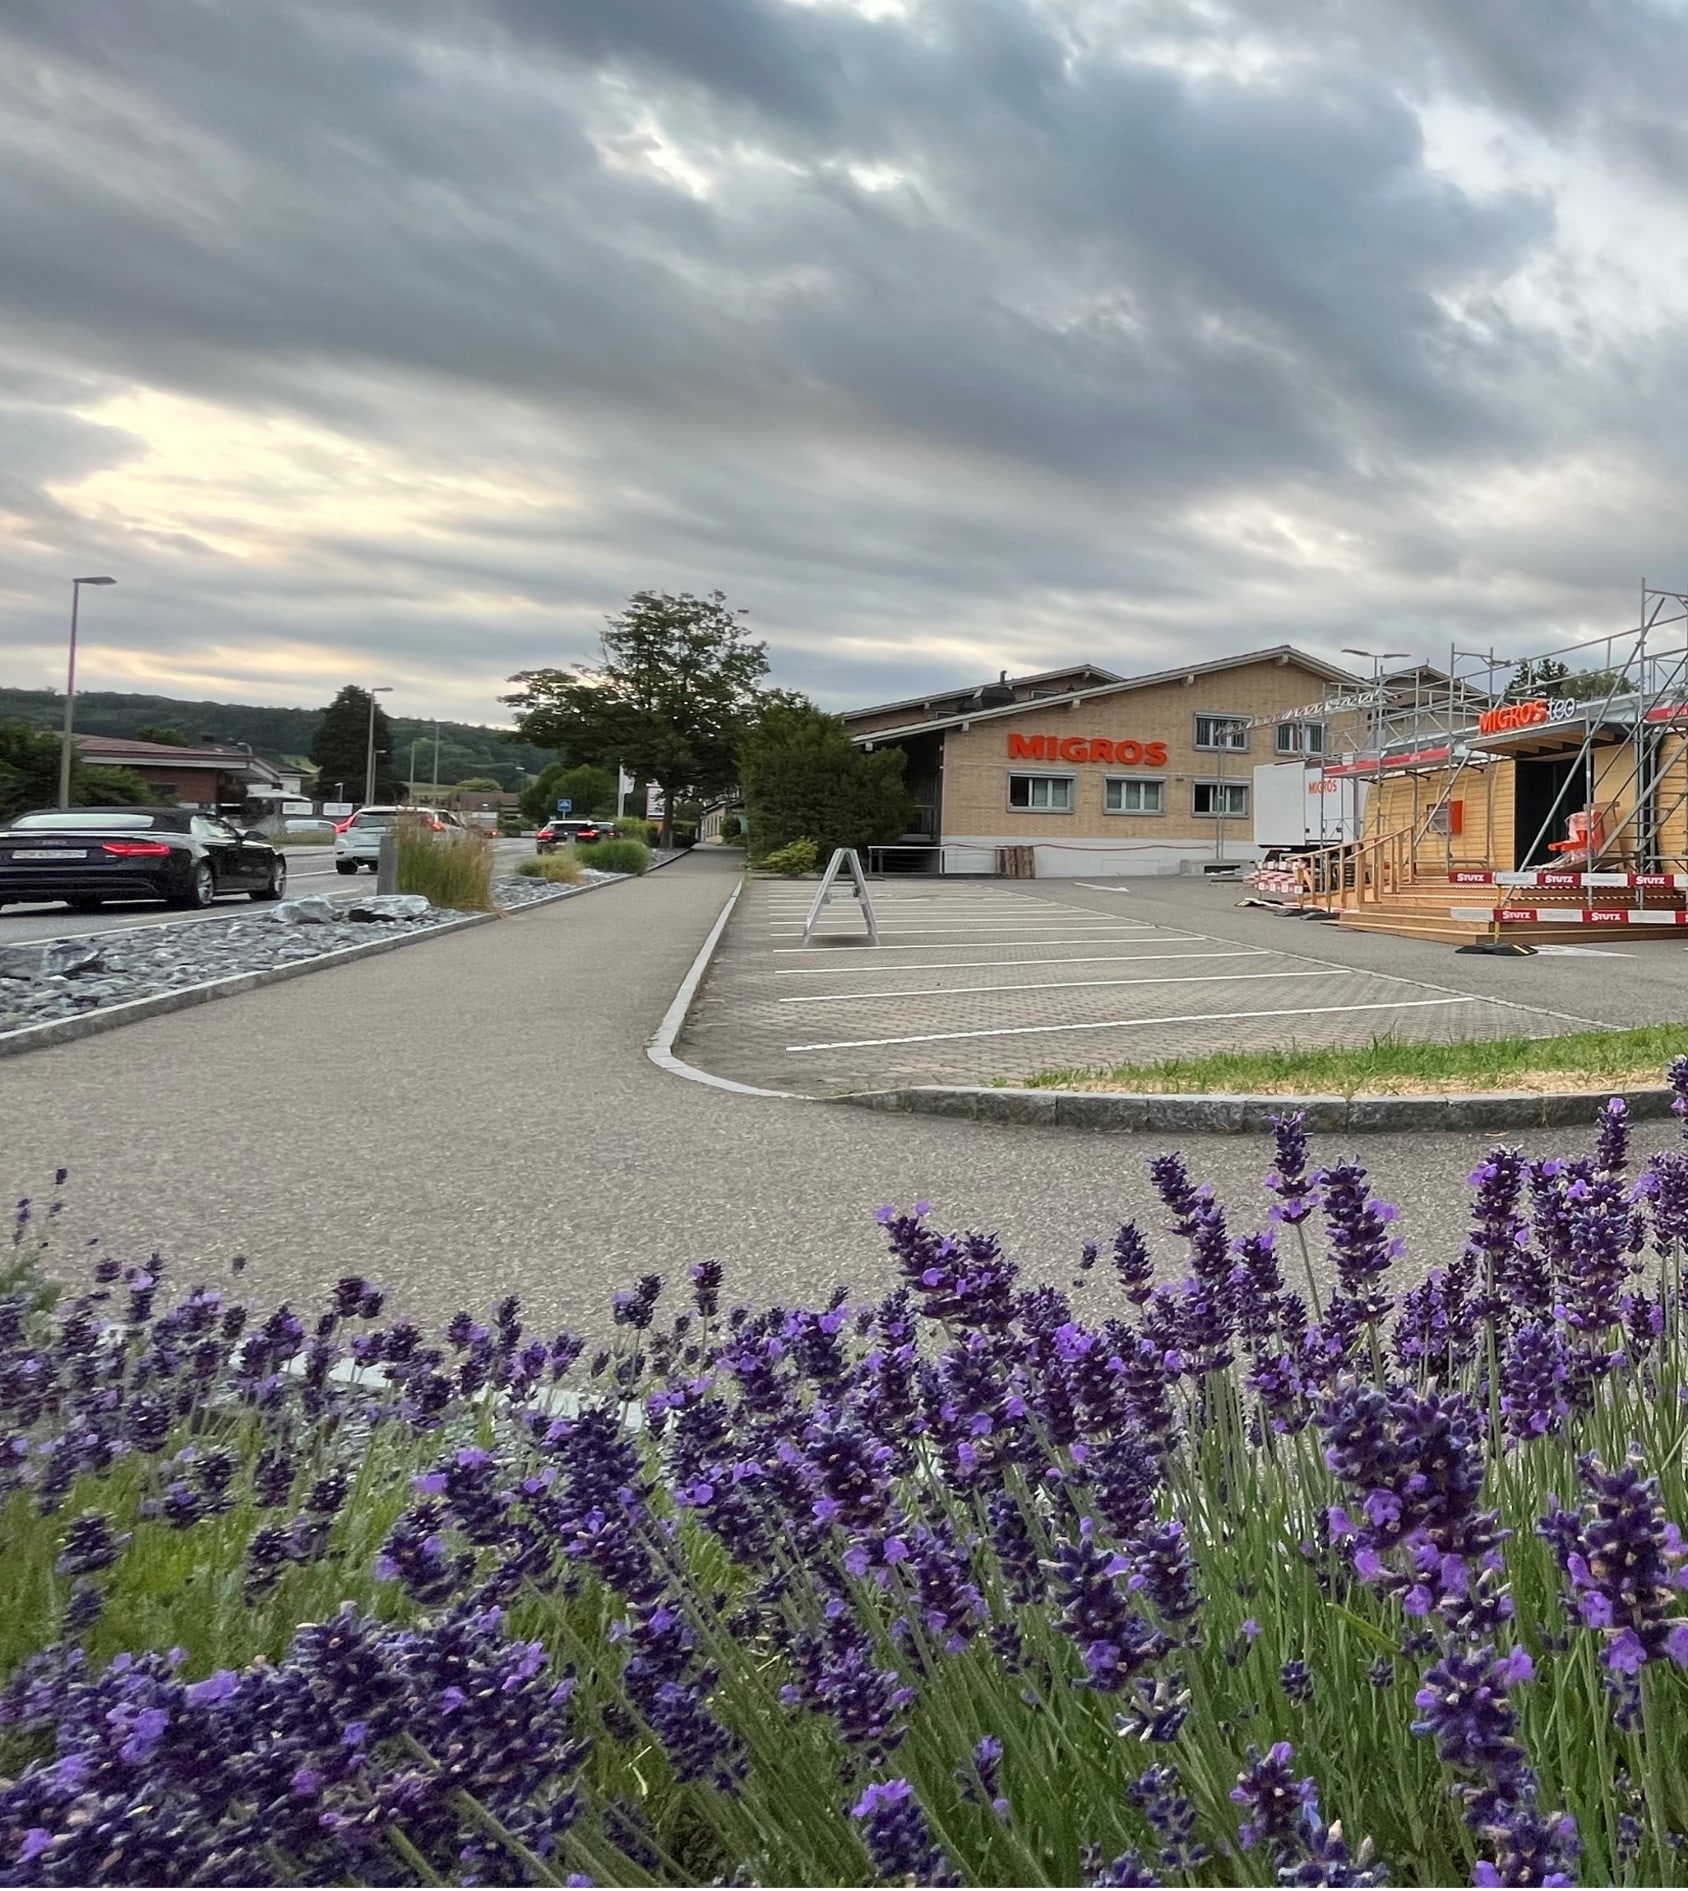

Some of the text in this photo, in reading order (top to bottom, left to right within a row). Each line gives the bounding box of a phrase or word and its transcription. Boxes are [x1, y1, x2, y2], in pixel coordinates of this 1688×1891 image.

[1479, 697, 1576, 734] MIGROS teo
[1008, 733, 1168, 767] MIGROS
[1308, 779, 1338, 794] MIGROS
[1456, 872, 1485, 882] STUTZ
[1545, 874, 1574, 884] STUTZ
[1635, 875, 1666, 885] STUTZ
[1502, 910, 1531, 920] STUTZ
[1591, 911, 1621, 921] STUTZ
